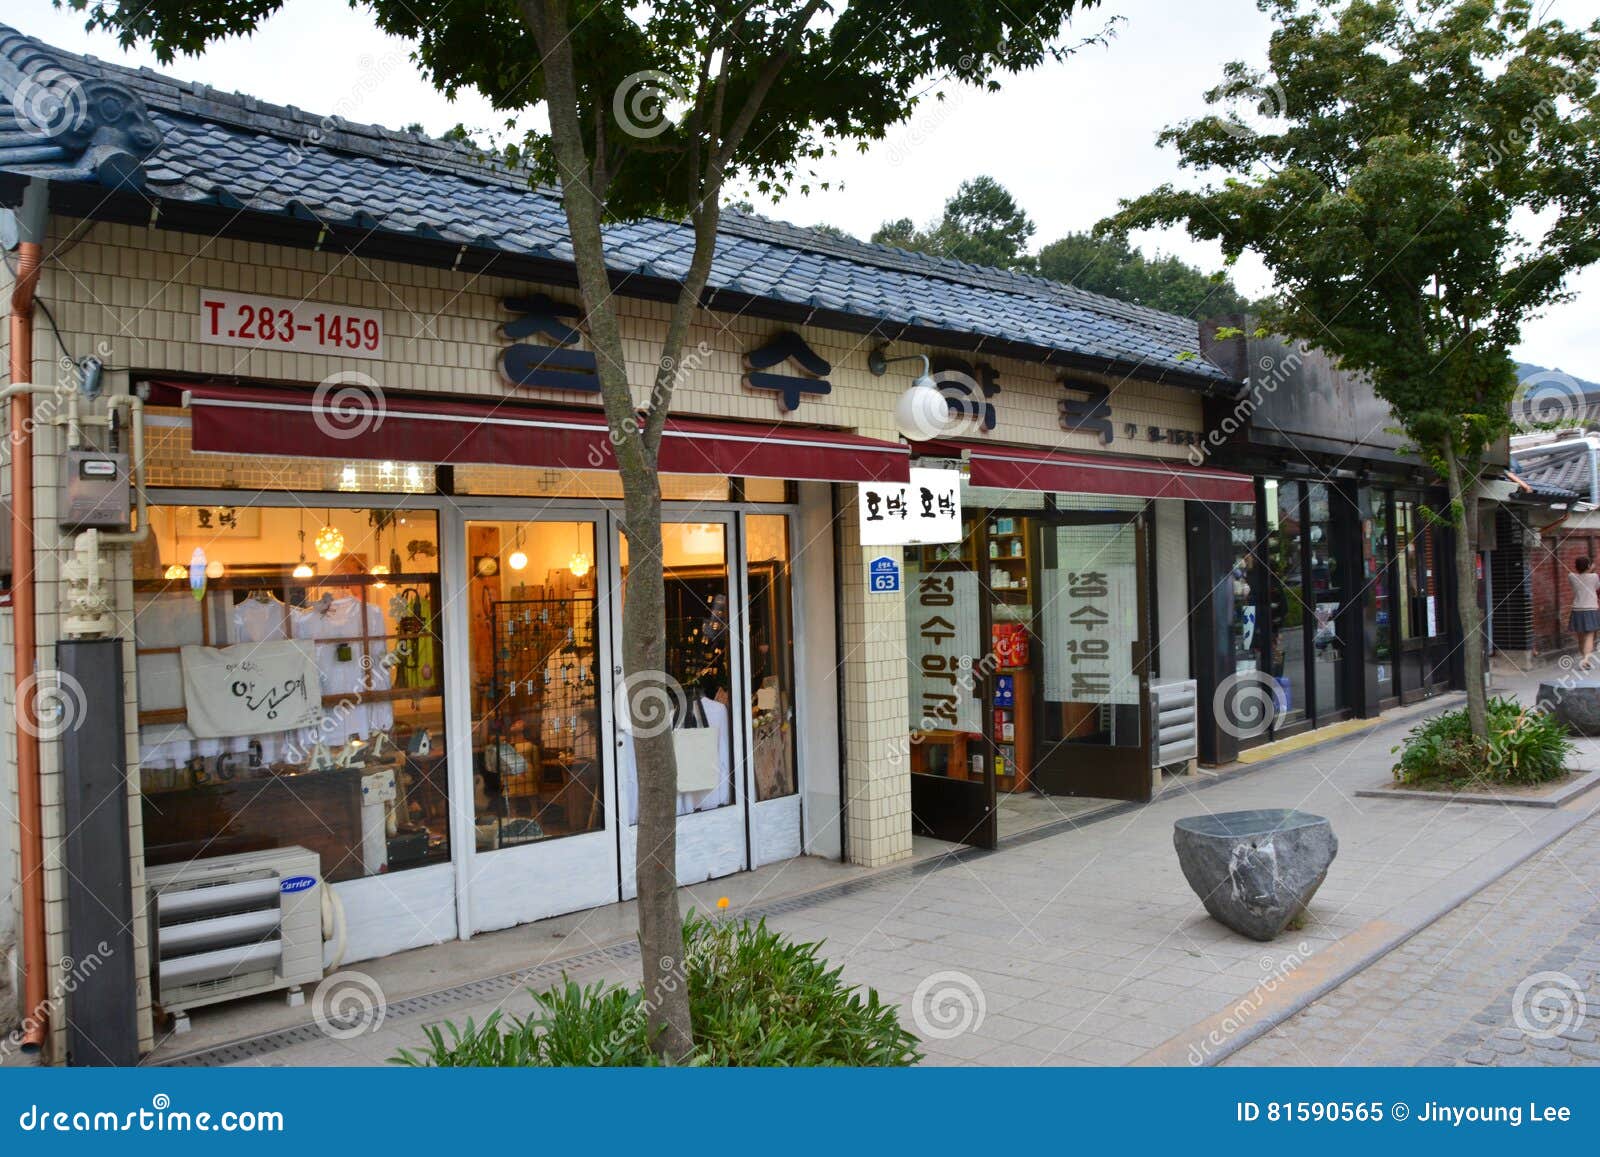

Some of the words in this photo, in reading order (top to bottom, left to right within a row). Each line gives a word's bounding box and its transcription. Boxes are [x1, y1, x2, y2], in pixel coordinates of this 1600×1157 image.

[205, 301, 380, 352] T.283-1459
[866, 488, 908, 522] 호박
[920, 486, 956, 520] 호박
[876, 575, 895, 589] 63
[280, 879, 312, 890] Carrier
